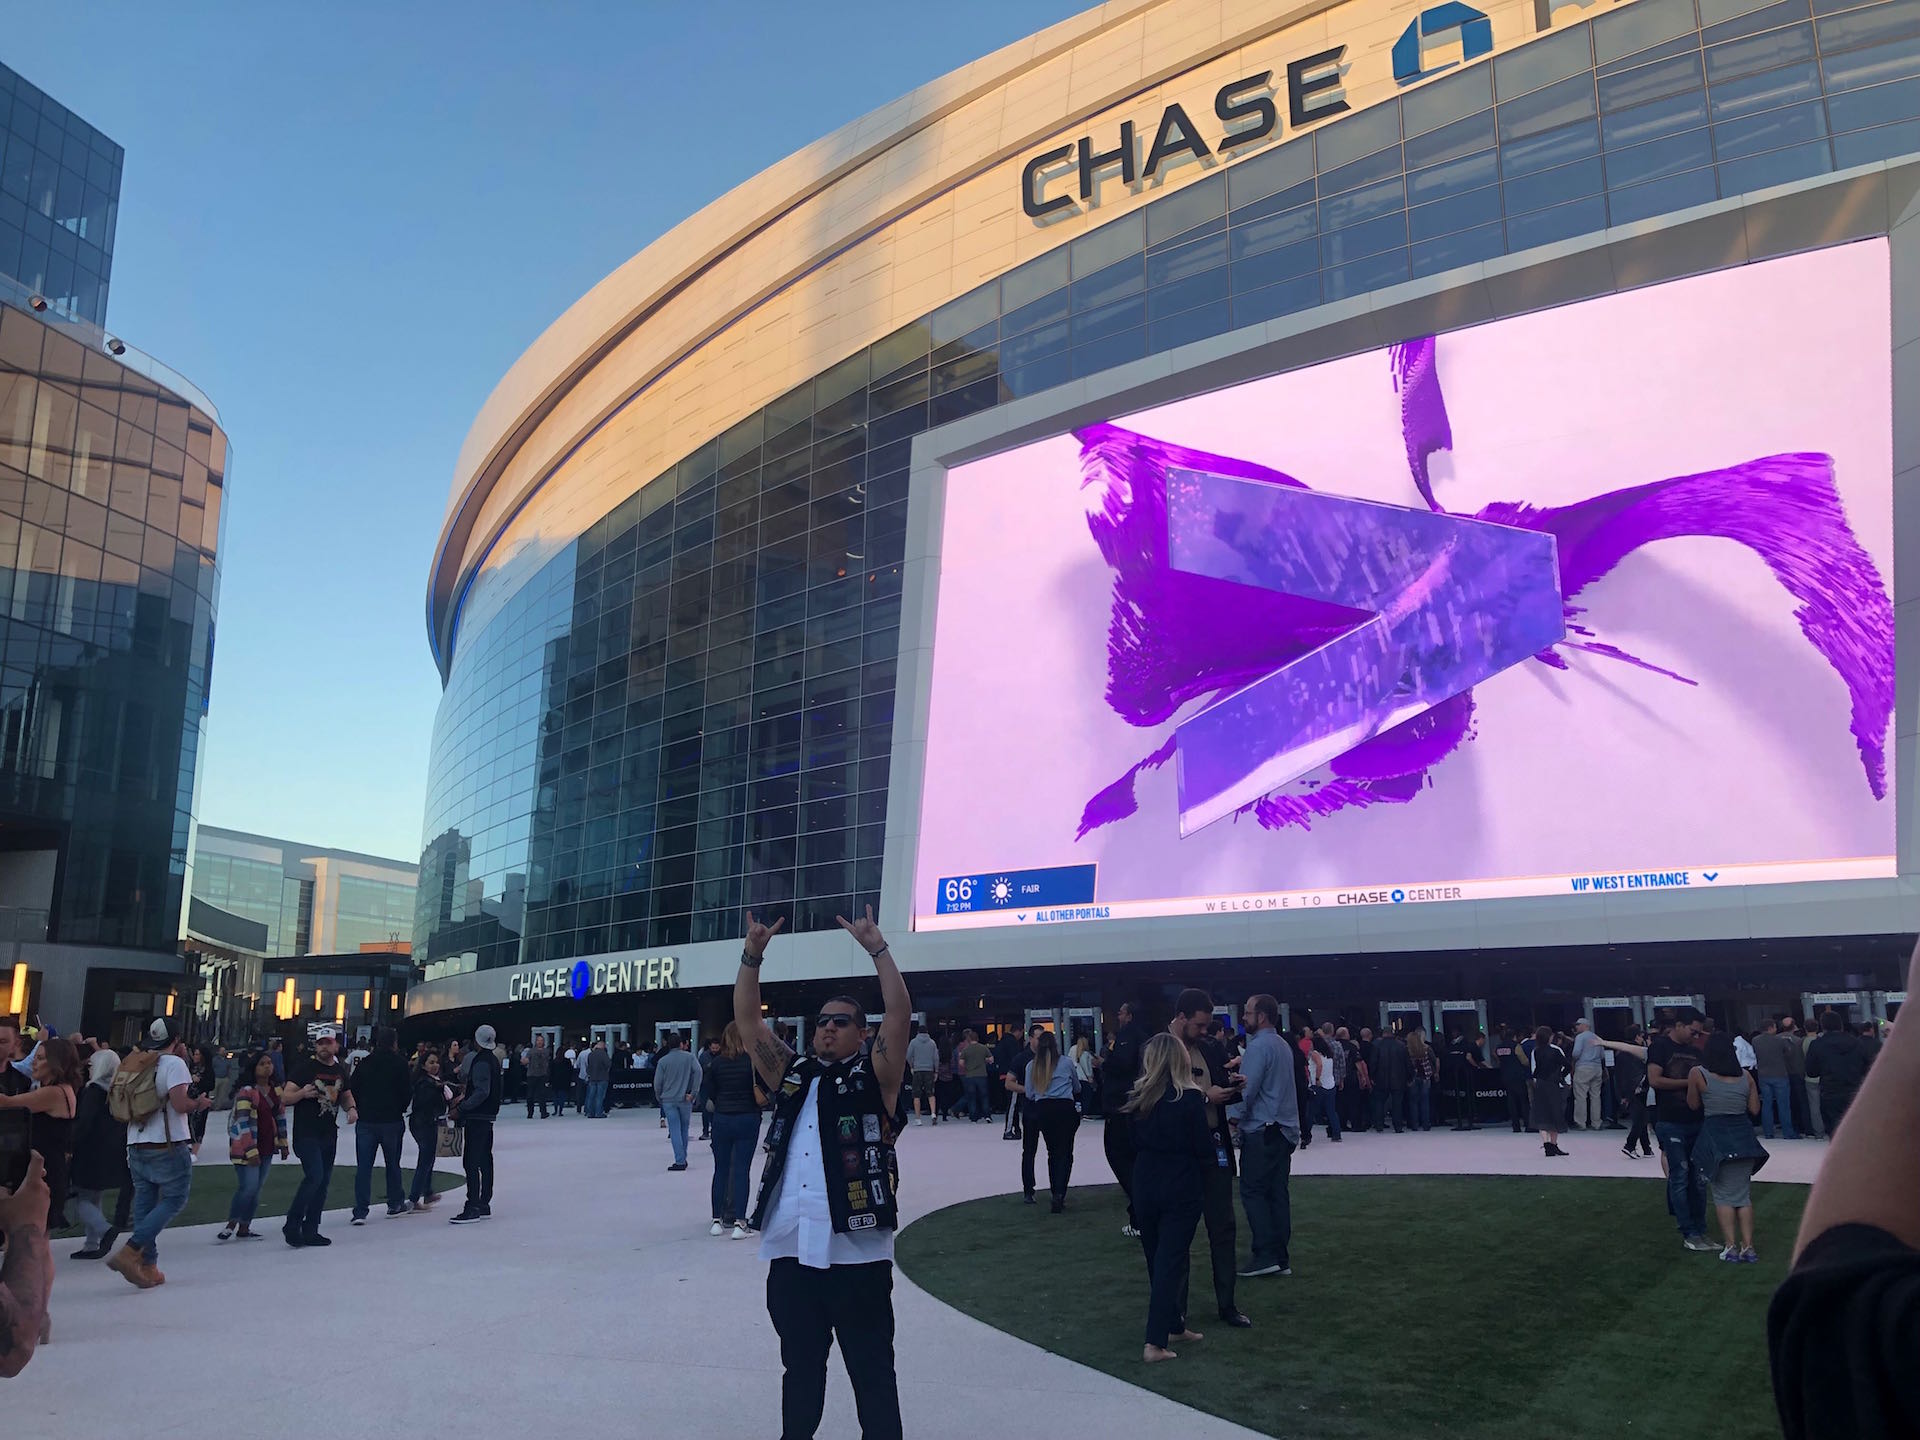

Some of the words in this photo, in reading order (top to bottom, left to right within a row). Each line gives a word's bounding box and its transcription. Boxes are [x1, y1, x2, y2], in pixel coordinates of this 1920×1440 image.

[1022, 45, 1351, 218] CHASE
[1021, 884, 1040, 894] FAIR
[1571, 877, 1590, 891] VIP
[1592, 875, 1625, 890] WEST
[1627, 872, 1691, 888] ENTRANCE
[960, 902, 972, 911] PM
[1206, 897, 1289, 912] WELCOME
[1302, 895, 1322, 906] TO
[1337, 891, 1388, 905] CHASE
[1408, 887, 1462, 901] CENTER
[1036, 911, 1049, 922] ALL
[1050, 909, 1075, 921] OTHER
[1075, 907, 1110, 919] PORTALS
[509, 967, 568, 1000] CHASE
[593, 956, 675, 994] CENTER
